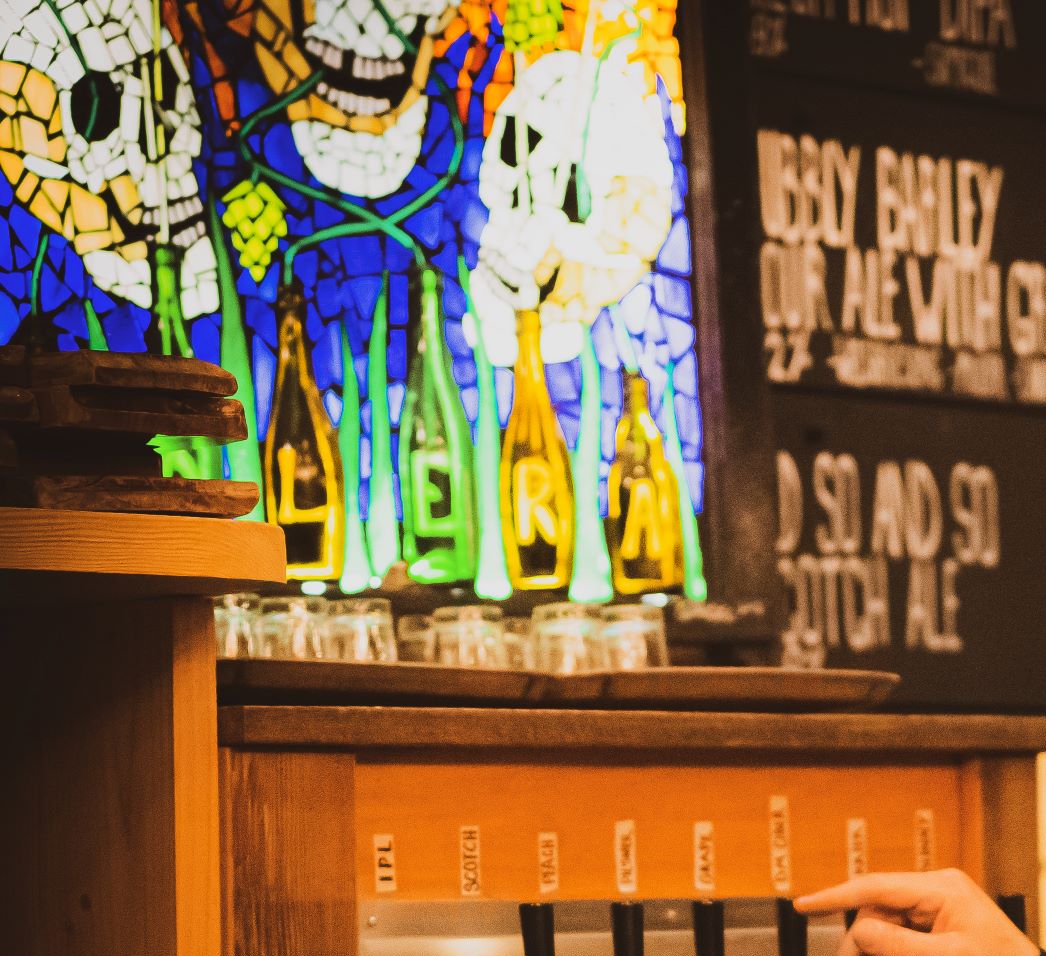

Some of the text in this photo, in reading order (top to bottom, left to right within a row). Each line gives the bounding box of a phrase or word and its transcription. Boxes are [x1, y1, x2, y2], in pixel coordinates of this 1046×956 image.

[841, 245, 901, 339] ALE
[905, 256, 1002, 352] WITH
[906, 556, 964, 653] ALE
[377, 839, 394, 882] IPL
[461, 829, 481, 892] SCOTCH
